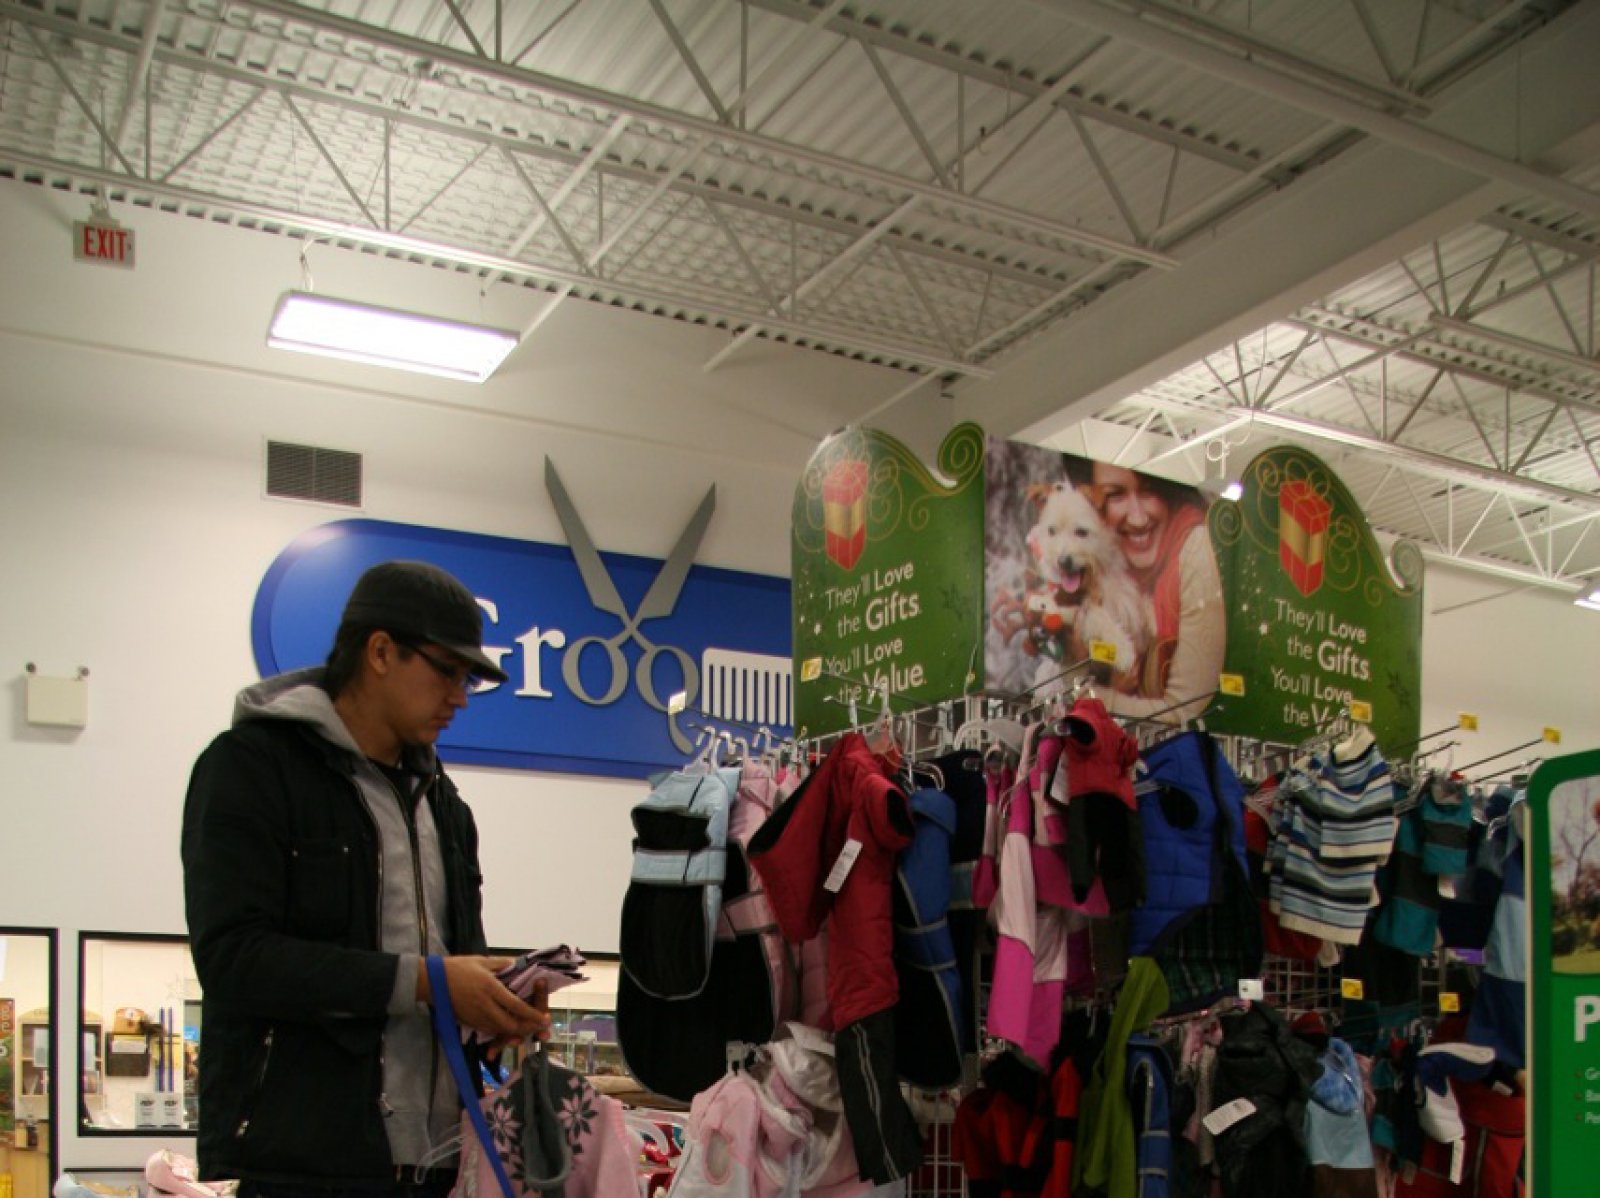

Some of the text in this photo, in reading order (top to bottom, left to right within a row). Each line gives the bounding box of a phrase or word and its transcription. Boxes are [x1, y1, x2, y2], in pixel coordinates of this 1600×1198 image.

[83, 226, 128, 261] EXIT
[825, 562, 914, 611] They'll Love
[838, 614, 860, 638] the
[1275, 599, 1366, 644] They'll Love
[826, 638, 902, 677] You'll Love
[1287, 635, 1313, 660] the
[838, 684, 862, 706] the
[1271, 666, 1310, 696] You'll
[1314, 677, 1353, 704] Love
[1283, 702, 1309, 727] the
